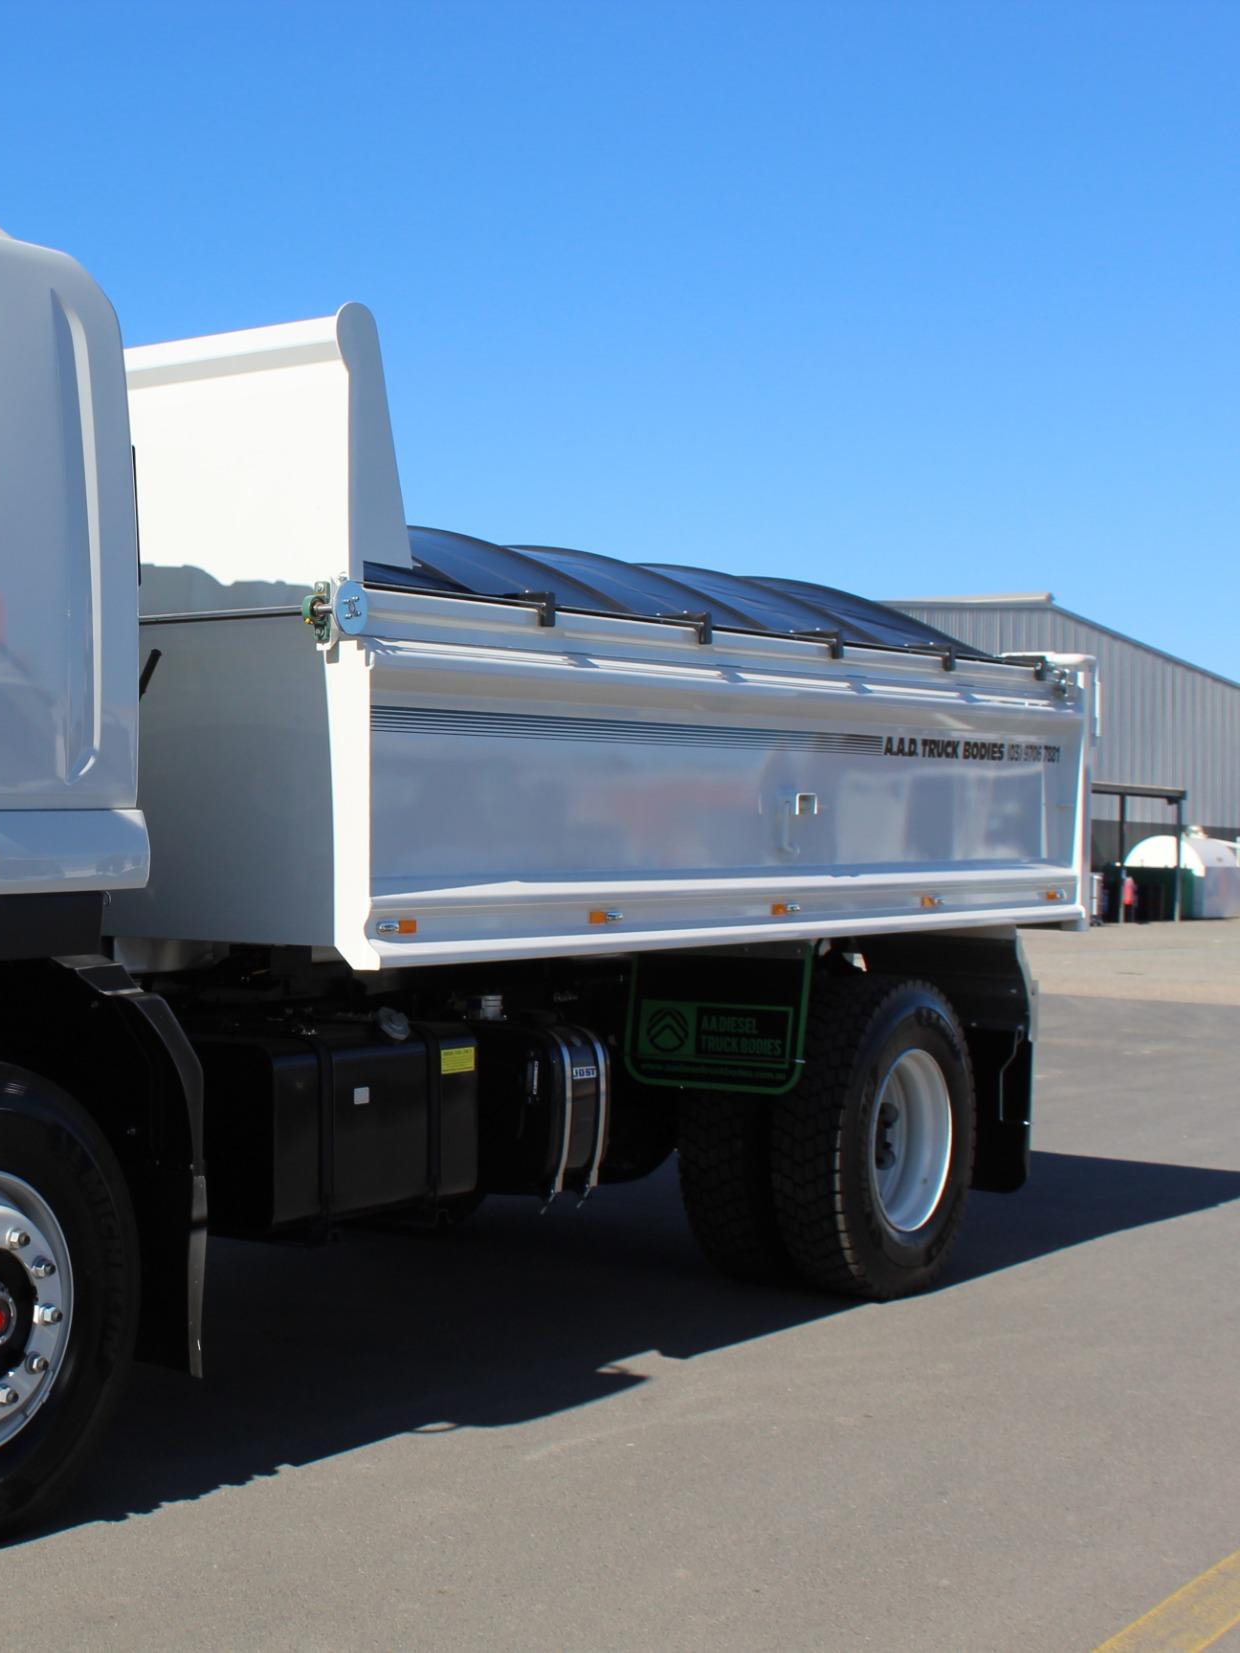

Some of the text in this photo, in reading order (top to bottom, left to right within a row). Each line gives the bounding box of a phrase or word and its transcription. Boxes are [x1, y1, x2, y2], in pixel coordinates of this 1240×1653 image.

[921, 739, 960, 759] TRUCK
[962, 741, 1005, 761] BODIES
[719, 1016, 759, 1034] DIESEL
[701, 1035, 782, 1056] TRUCK BODIES
